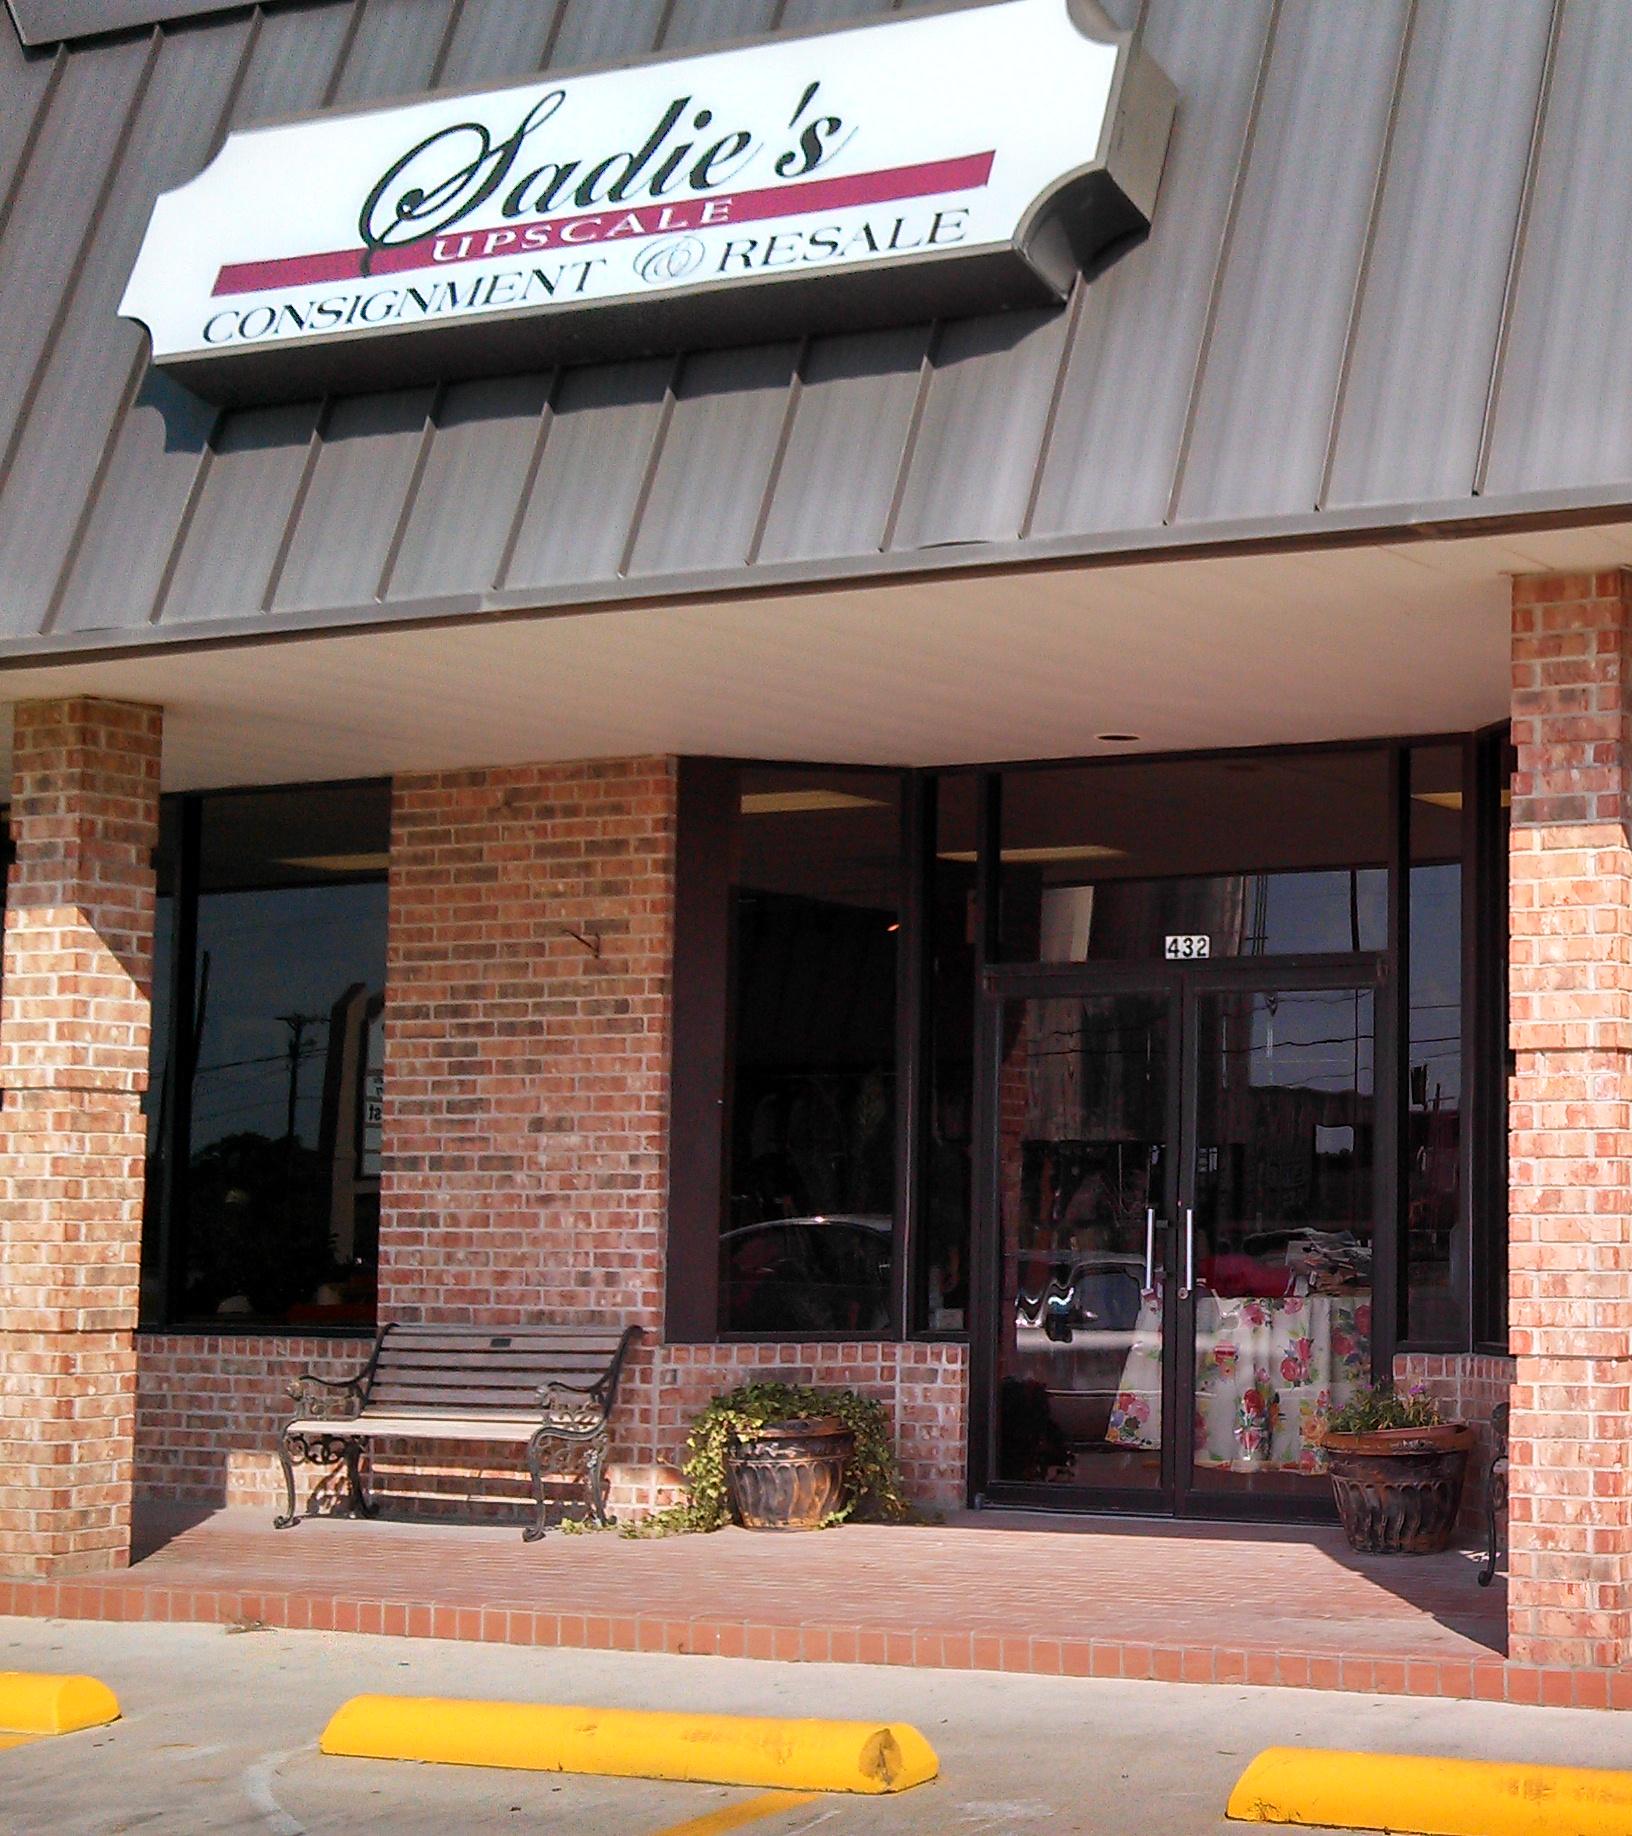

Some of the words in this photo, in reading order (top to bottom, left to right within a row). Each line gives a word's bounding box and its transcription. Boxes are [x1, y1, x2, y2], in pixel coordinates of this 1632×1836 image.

[359, 81, 859, 277] Sadie's
[202, 258, 607, 344] CONSIGNMENT
[716, 207, 970, 273] RESALE
[432, 198, 735, 263] UPSCALE
[1167, 937, 1207, 958] 432
